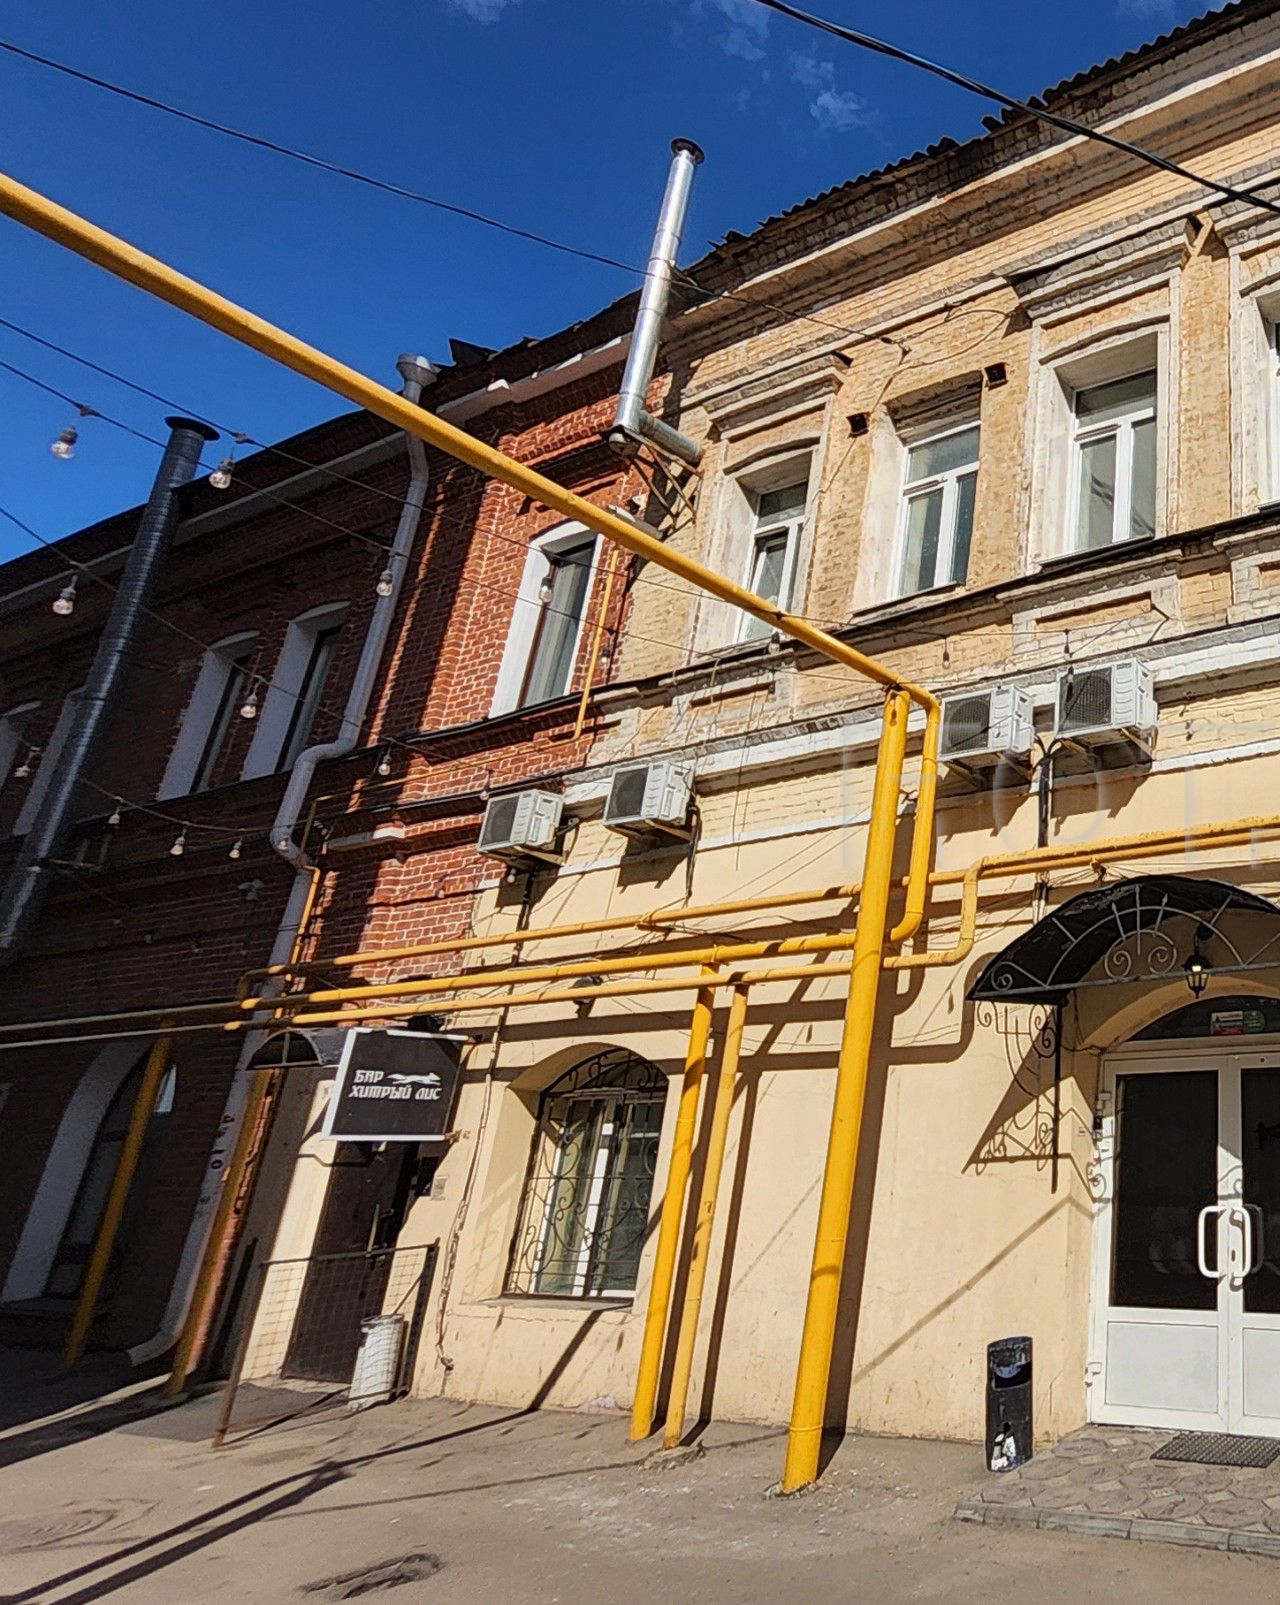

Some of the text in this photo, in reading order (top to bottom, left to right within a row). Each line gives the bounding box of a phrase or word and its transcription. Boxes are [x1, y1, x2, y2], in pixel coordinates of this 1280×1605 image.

[353, 1070, 385, 1083] БАР
[348, 1084, 442, 1100] ХИТРЫЙ ЛИС
